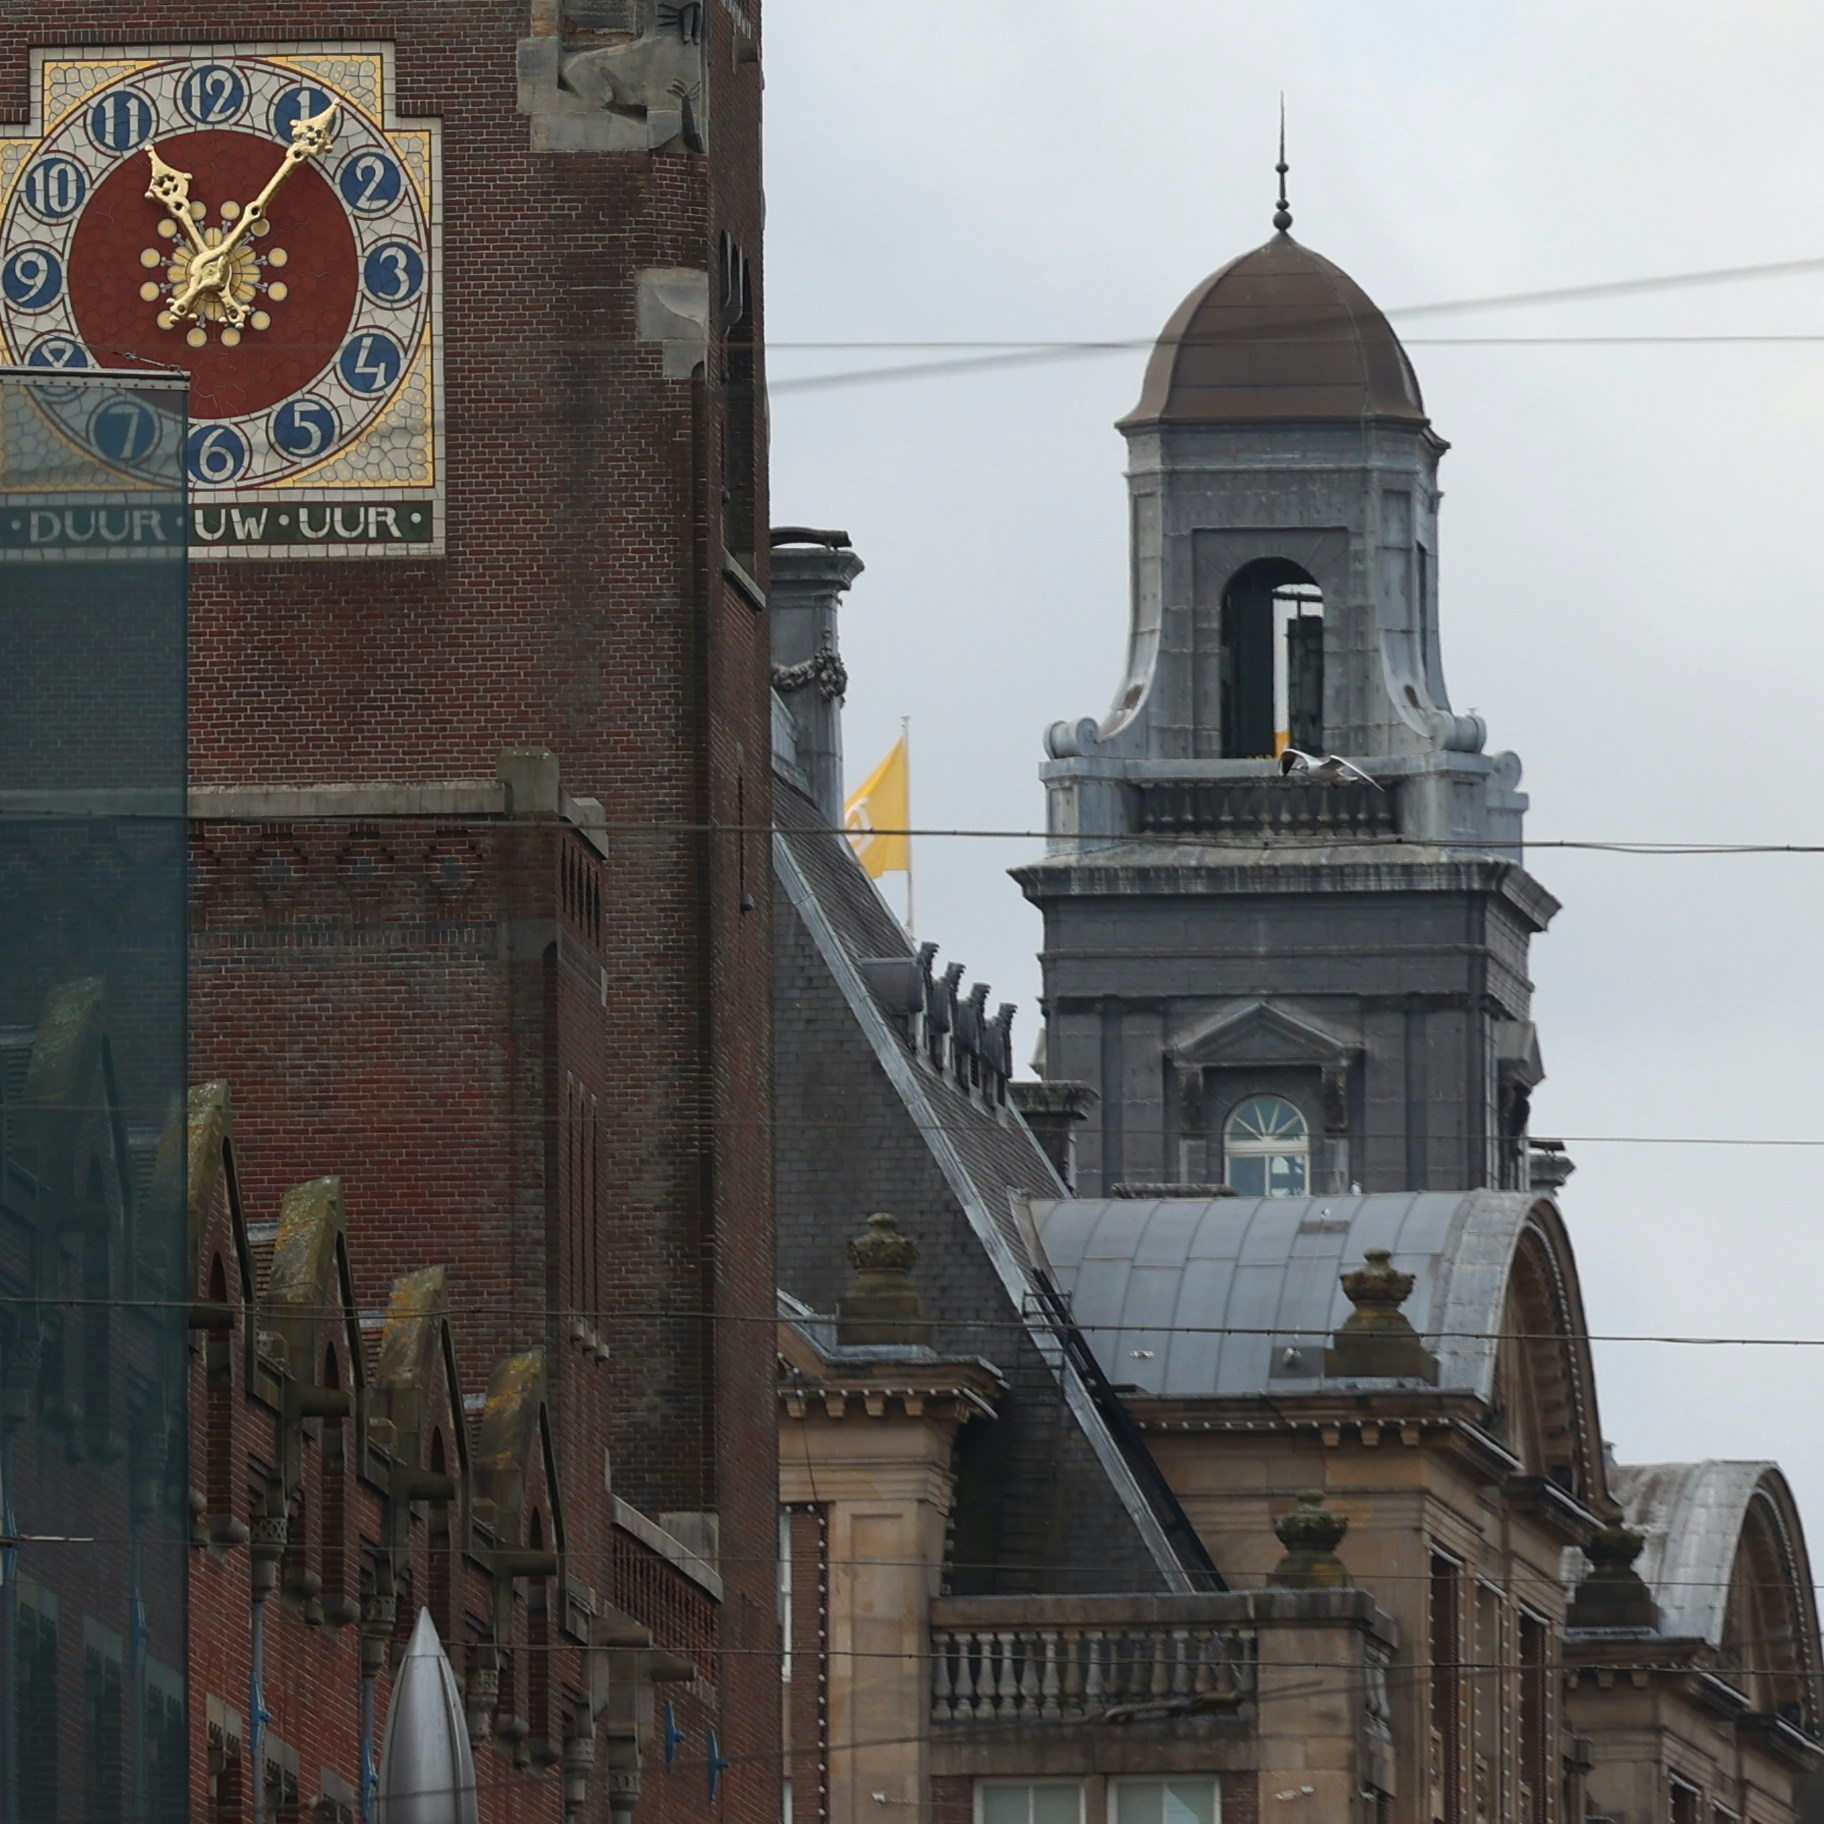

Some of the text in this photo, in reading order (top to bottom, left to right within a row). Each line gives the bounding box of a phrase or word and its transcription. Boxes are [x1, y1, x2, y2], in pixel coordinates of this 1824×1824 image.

[104, 93, 141, 149] 11
[188, 70, 236, 121] 12
[32, 165, 69, 219] 10
[355, 156, 389, 208] 2
[14, 253, 48, 308] 9
[379, 244, 409, 306] 3
[355, 338, 387, 389] 4
[107, 407, 143, 459] 7
[294, 402, 323, 453] 5
[199, 430, 231, 482] 6
[30, 507, 403, 542] DUUR UW UUR
